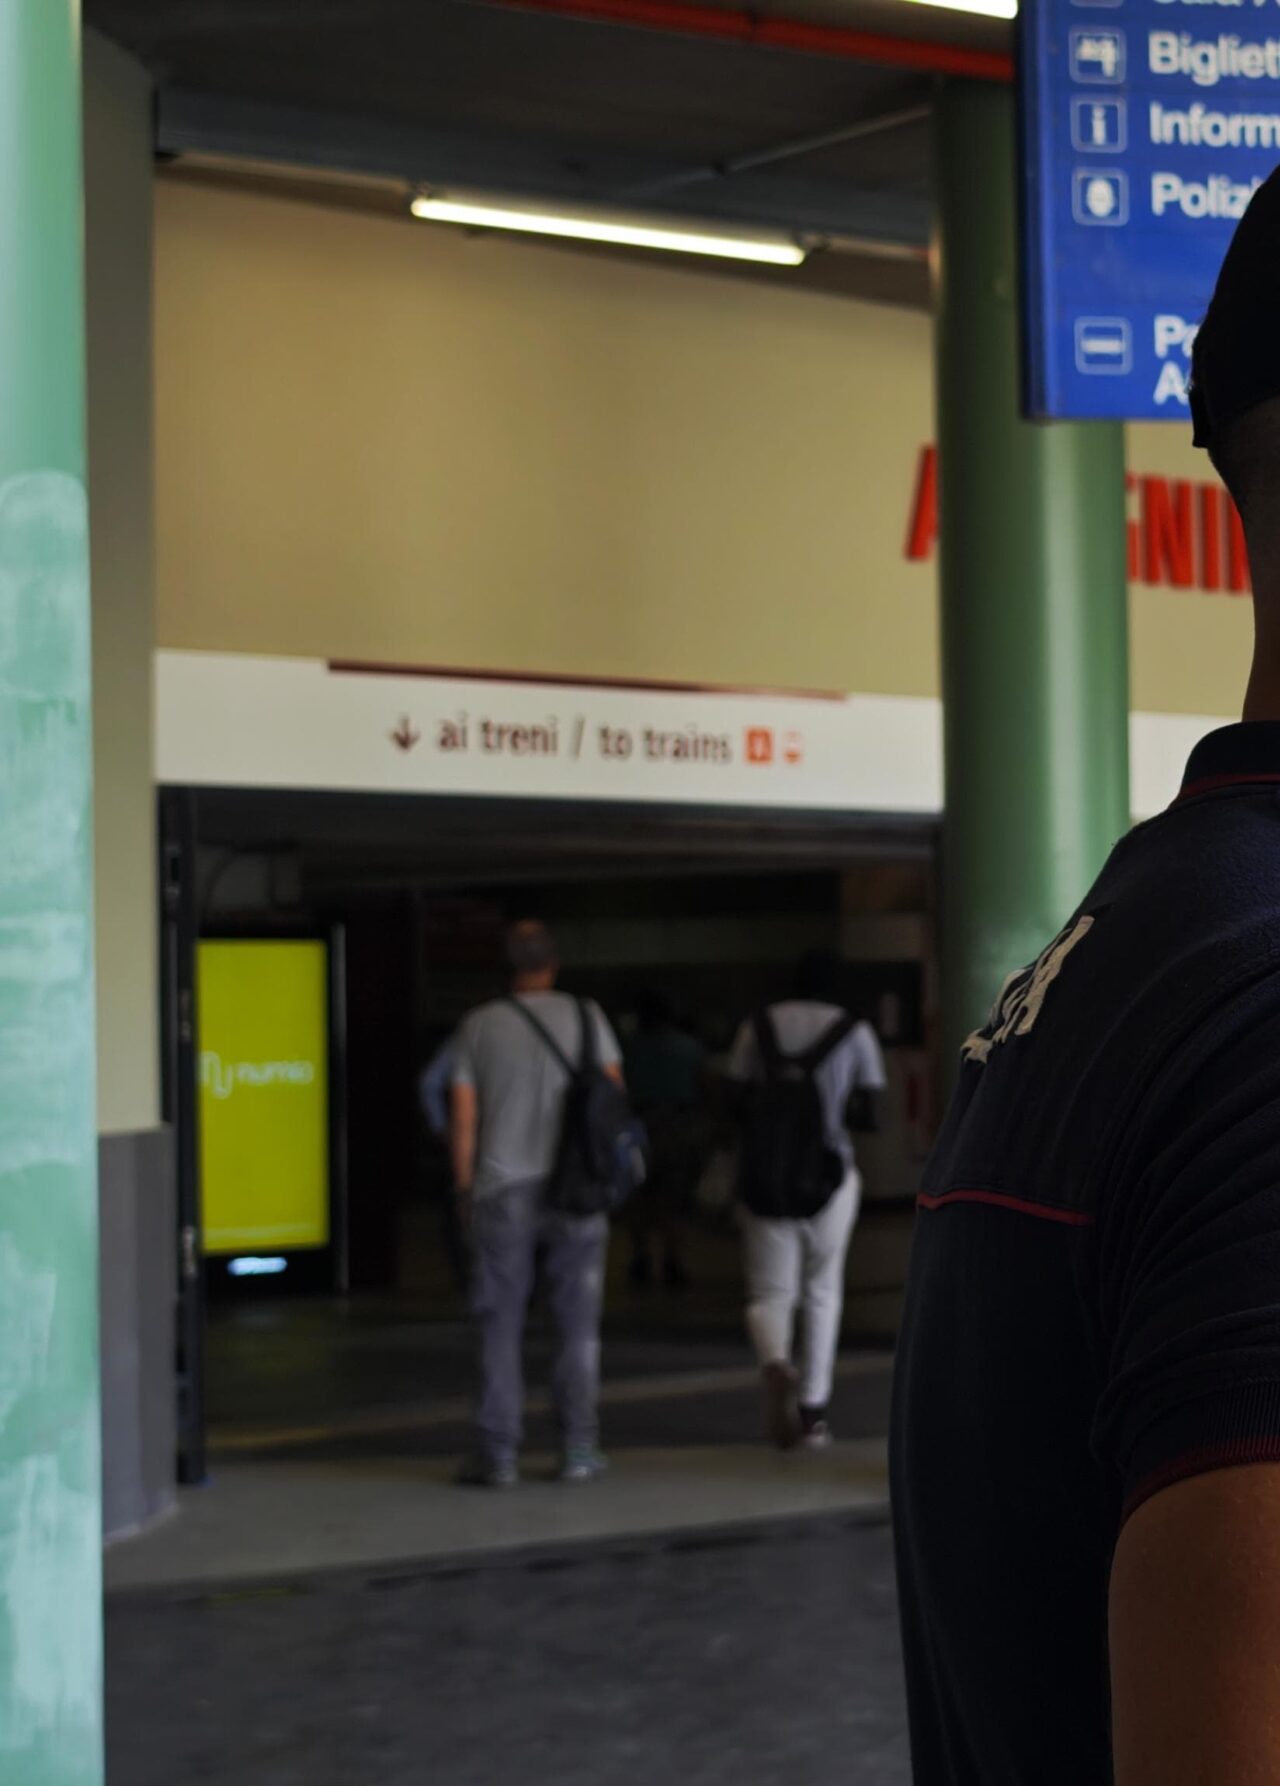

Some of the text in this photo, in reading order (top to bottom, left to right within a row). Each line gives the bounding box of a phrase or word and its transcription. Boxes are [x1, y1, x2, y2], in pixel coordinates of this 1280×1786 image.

[437, 709, 468, 752] ai
[480, 715, 558, 757] treni
[600, 724, 632, 760] to
[643, 724, 732, 763] trains
